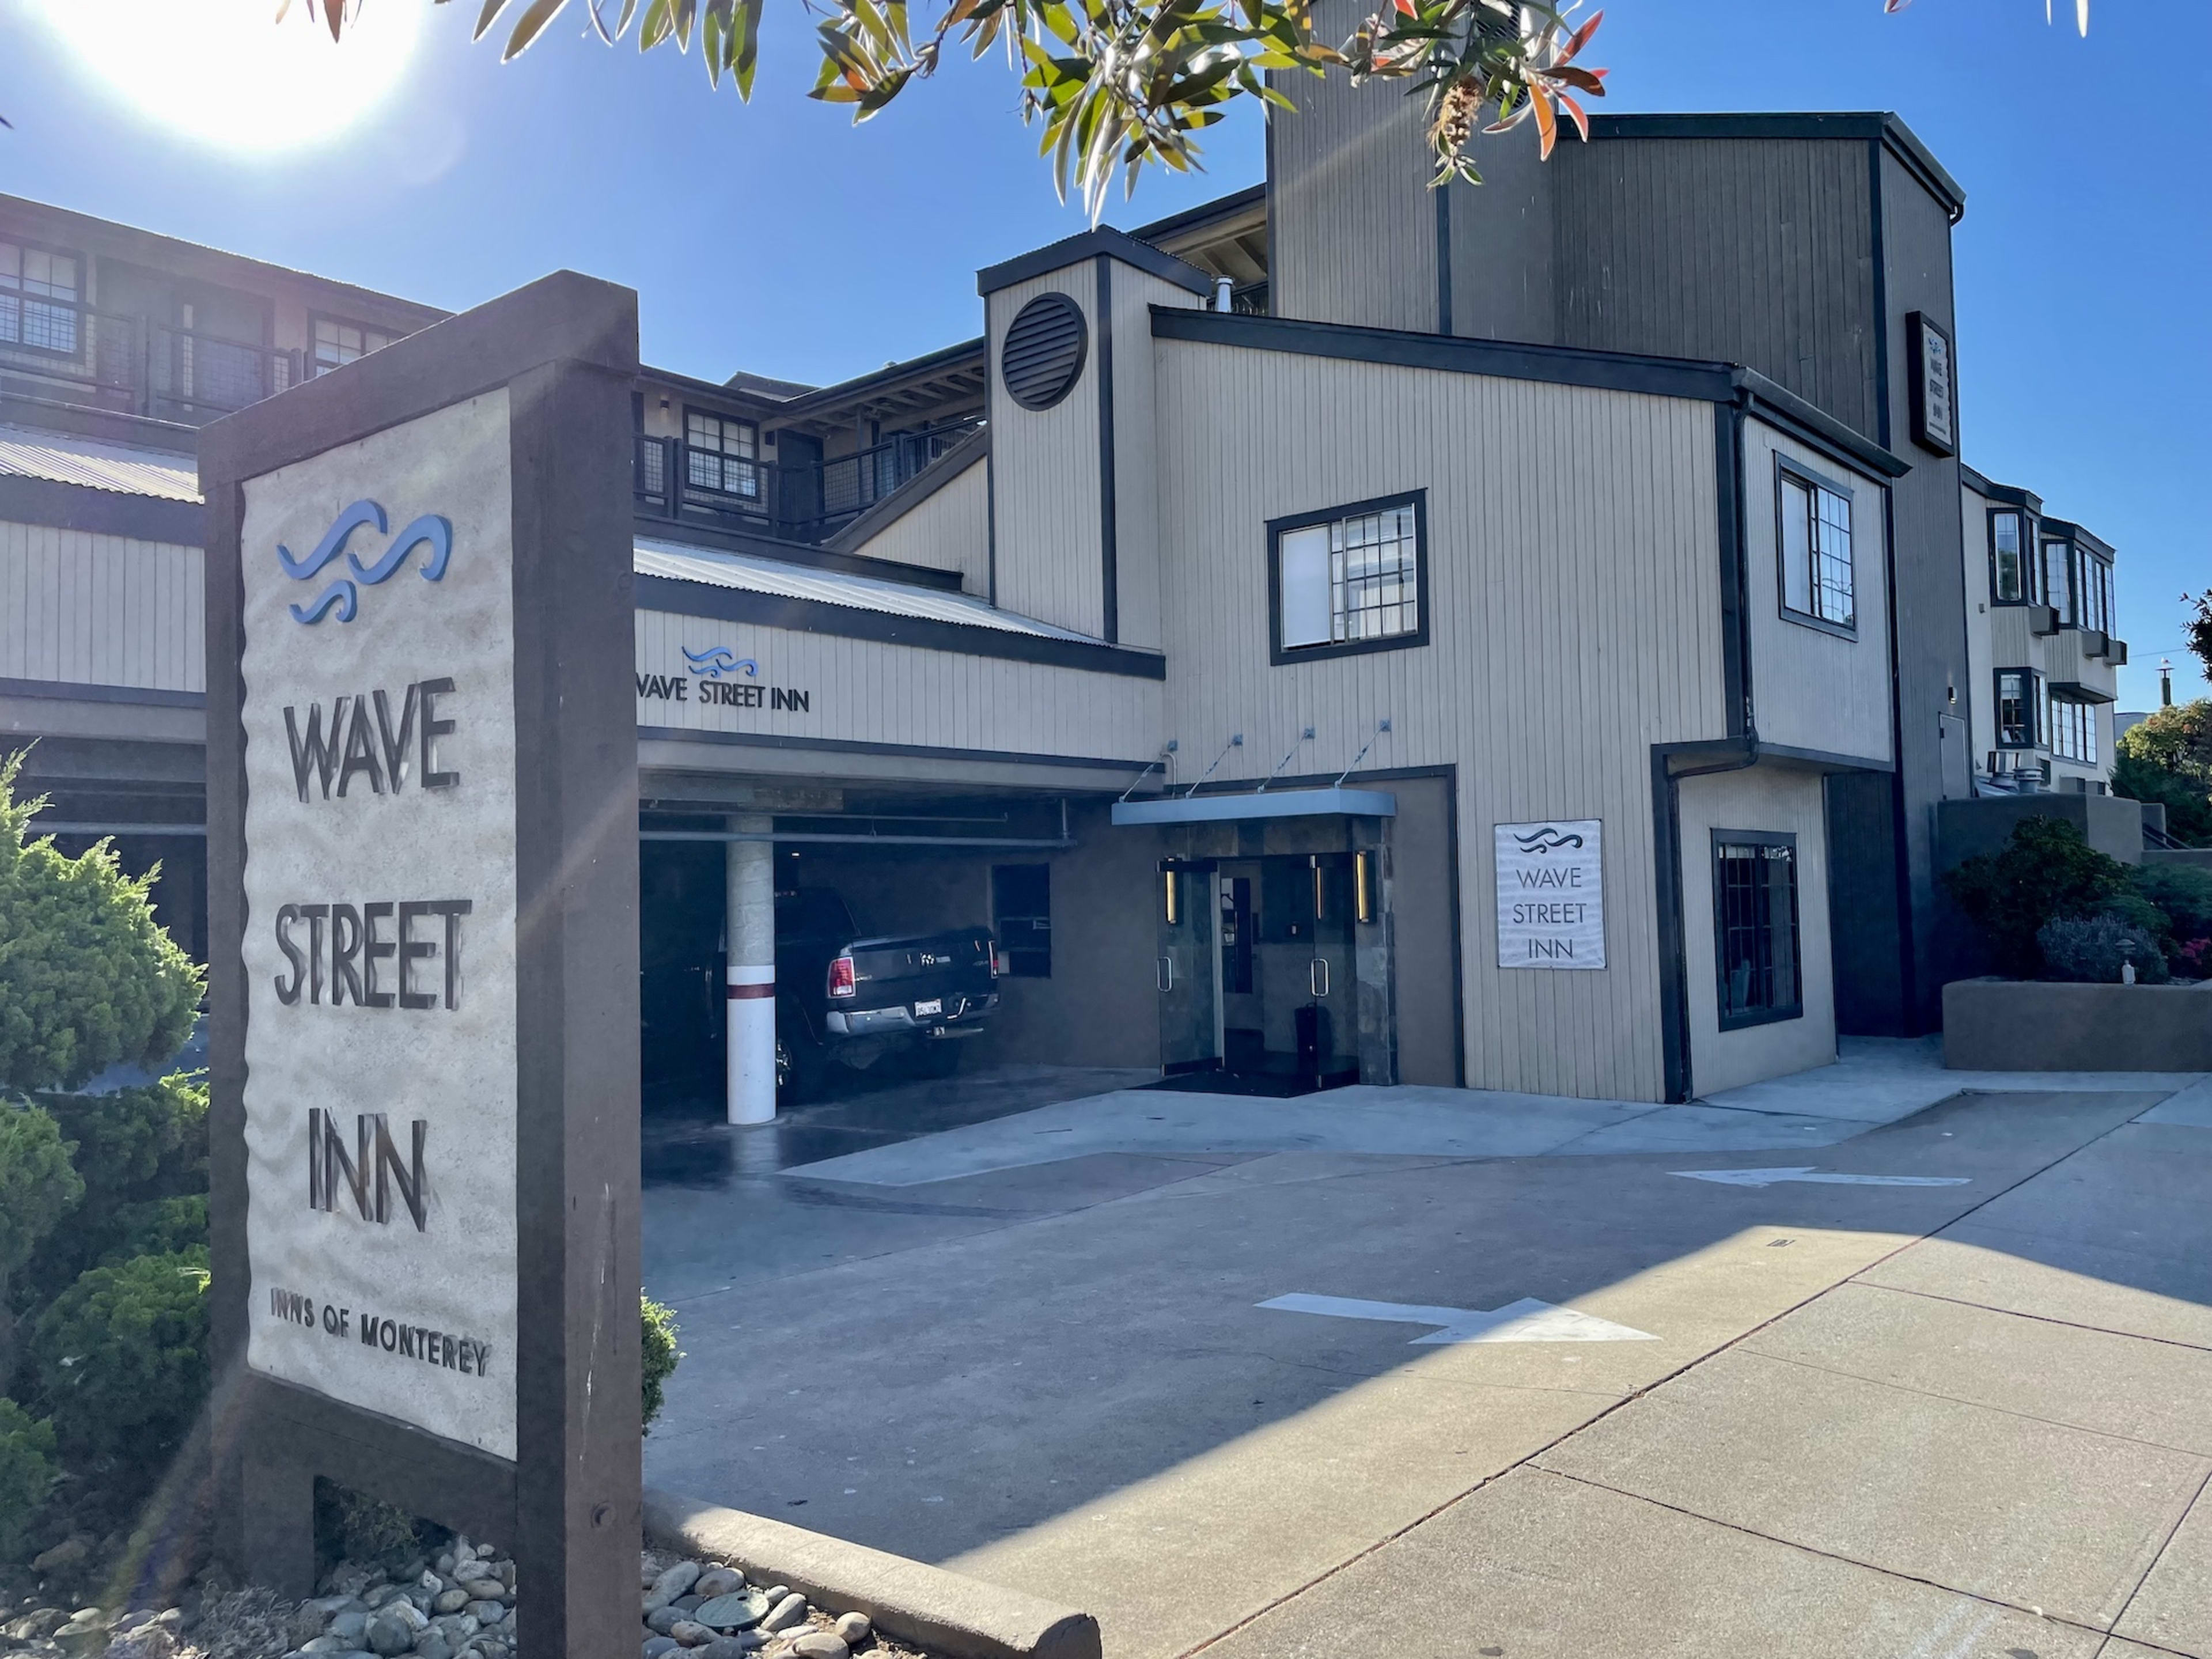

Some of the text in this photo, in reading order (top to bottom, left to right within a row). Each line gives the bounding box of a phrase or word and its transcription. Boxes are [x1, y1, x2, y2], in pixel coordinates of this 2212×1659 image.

[699, 680, 766, 709] STREET
[771, 687, 809, 713] INN
[283, 676, 460, 804] WAVE
[1516, 868, 1582, 888] WAVE
[1513, 903, 1587, 924] STREET
[274, 899, 472, 1012] STREET
[1528, 938, 1573, 959] INN
[309, 1106, 428, 1233] INN
[270, 1287, 493, 1377] INNS OF MONTEREY
